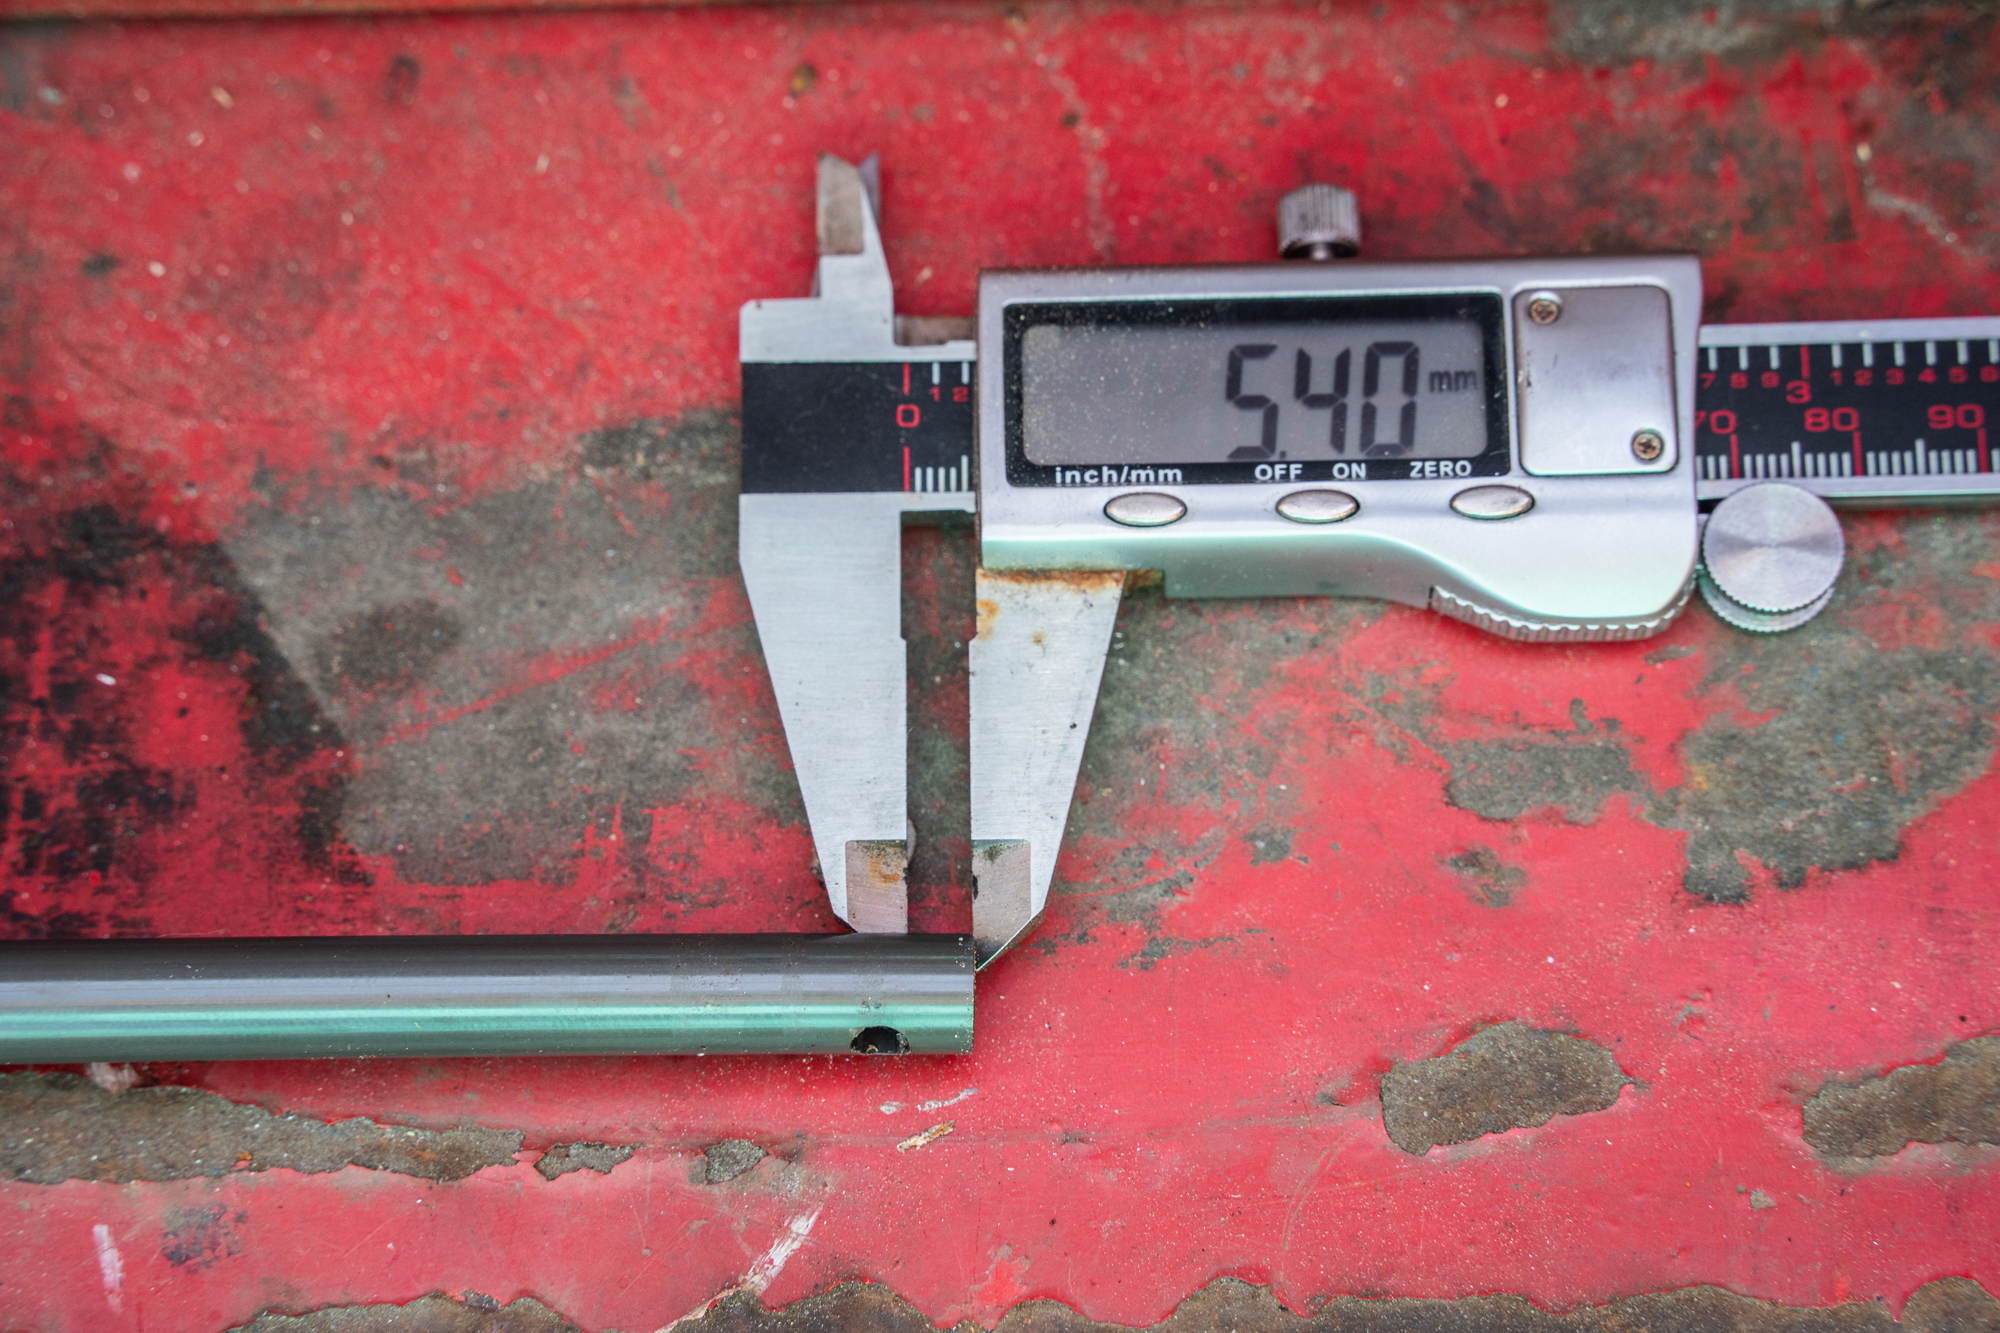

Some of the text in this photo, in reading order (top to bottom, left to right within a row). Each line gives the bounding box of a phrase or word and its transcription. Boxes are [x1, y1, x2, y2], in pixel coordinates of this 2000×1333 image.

[1429, 370, 1478, 393] mm
[1700, 372, 1716, 389] 7
[1831, 370, 1843, 386] 1
[1854, 369, 1873, 386] 2
[1885, 368, 1905, 386] 3
[1917, 367, 1937, 384] 4
[930, 386, 969, 402] 1 2
[1786, 380, 1812, 404] 3
[896, 404, 920, 428] 0
[1804, 407, 1860, 432] 80
[1927, 404, 1984, 429] 90
[1055, 460, 1472, 484] inch/mm OFF ON ZERO
